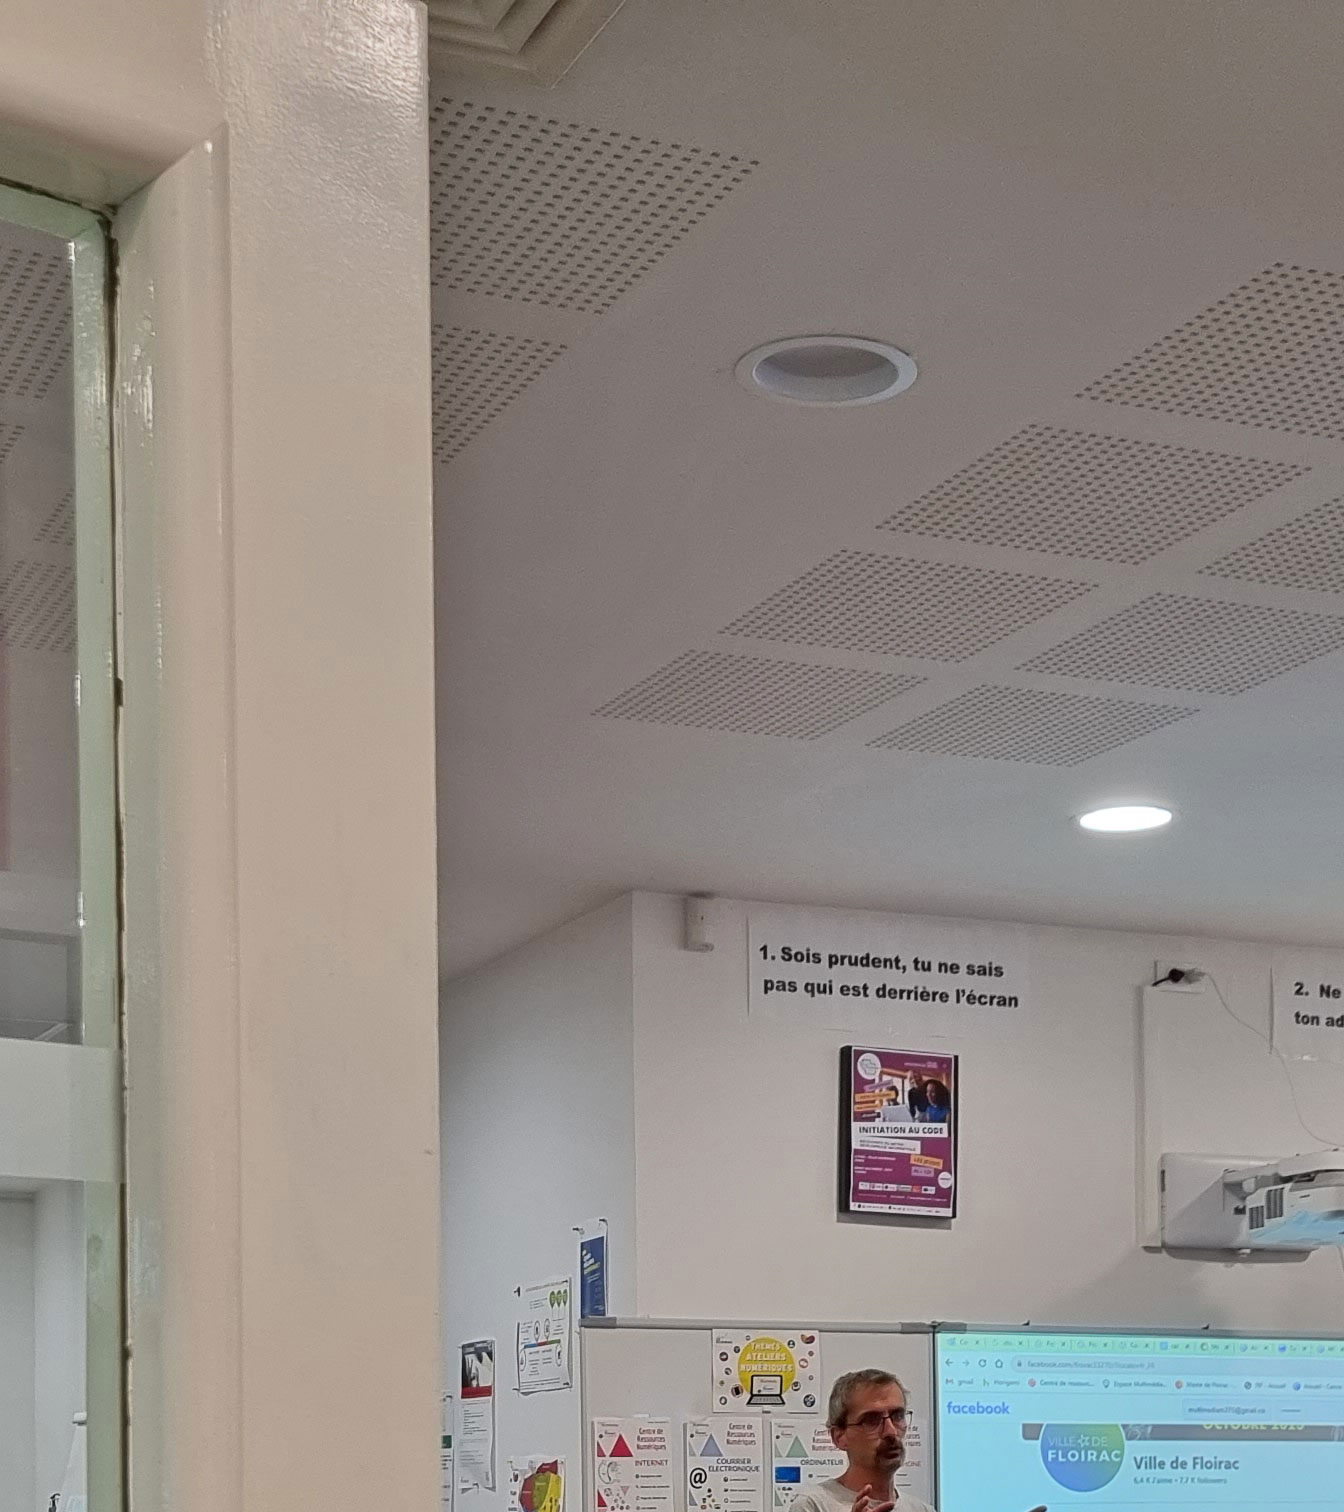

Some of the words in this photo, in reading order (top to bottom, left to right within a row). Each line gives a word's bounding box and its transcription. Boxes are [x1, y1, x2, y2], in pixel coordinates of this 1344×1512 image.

[759, 945, 775, 961] 1.
[781, 946, 822, 965] Sois
[828, 953, 907, 973] prudent,
[914, 957, 932, 973] tu
[938, 961, 960, 974] ne
[967, 962, 1004, 978] sais
[764, 978, 797, 994] pas
[804, 980, 832, 997] qui
[839, 984, 868, 998] est
[876, 983, 949, 1002] derrière
[1294, 983, 1308, 996] 2.
[1319, 985, 1341, 999] Ne
[1294, 1012, 1319, 1027] ton
[859, 1126, 906, 1134] INITIATION
[947, 1401, 1010, 1414] facebook
[1048, 1436, 1076, 1446] VILLE
[1092, 1436, 1108, 1446] DE
[1048, 1450, 1120, 1462] FLOIRAC
[708, 1465, 760, 1473] ELECTRONIQUE
[1134, 1456, 1164, 1470] Ville
[1170, 1457, 1188, 1470] de
[1193, 1457, 1239, 1470] Floirac
